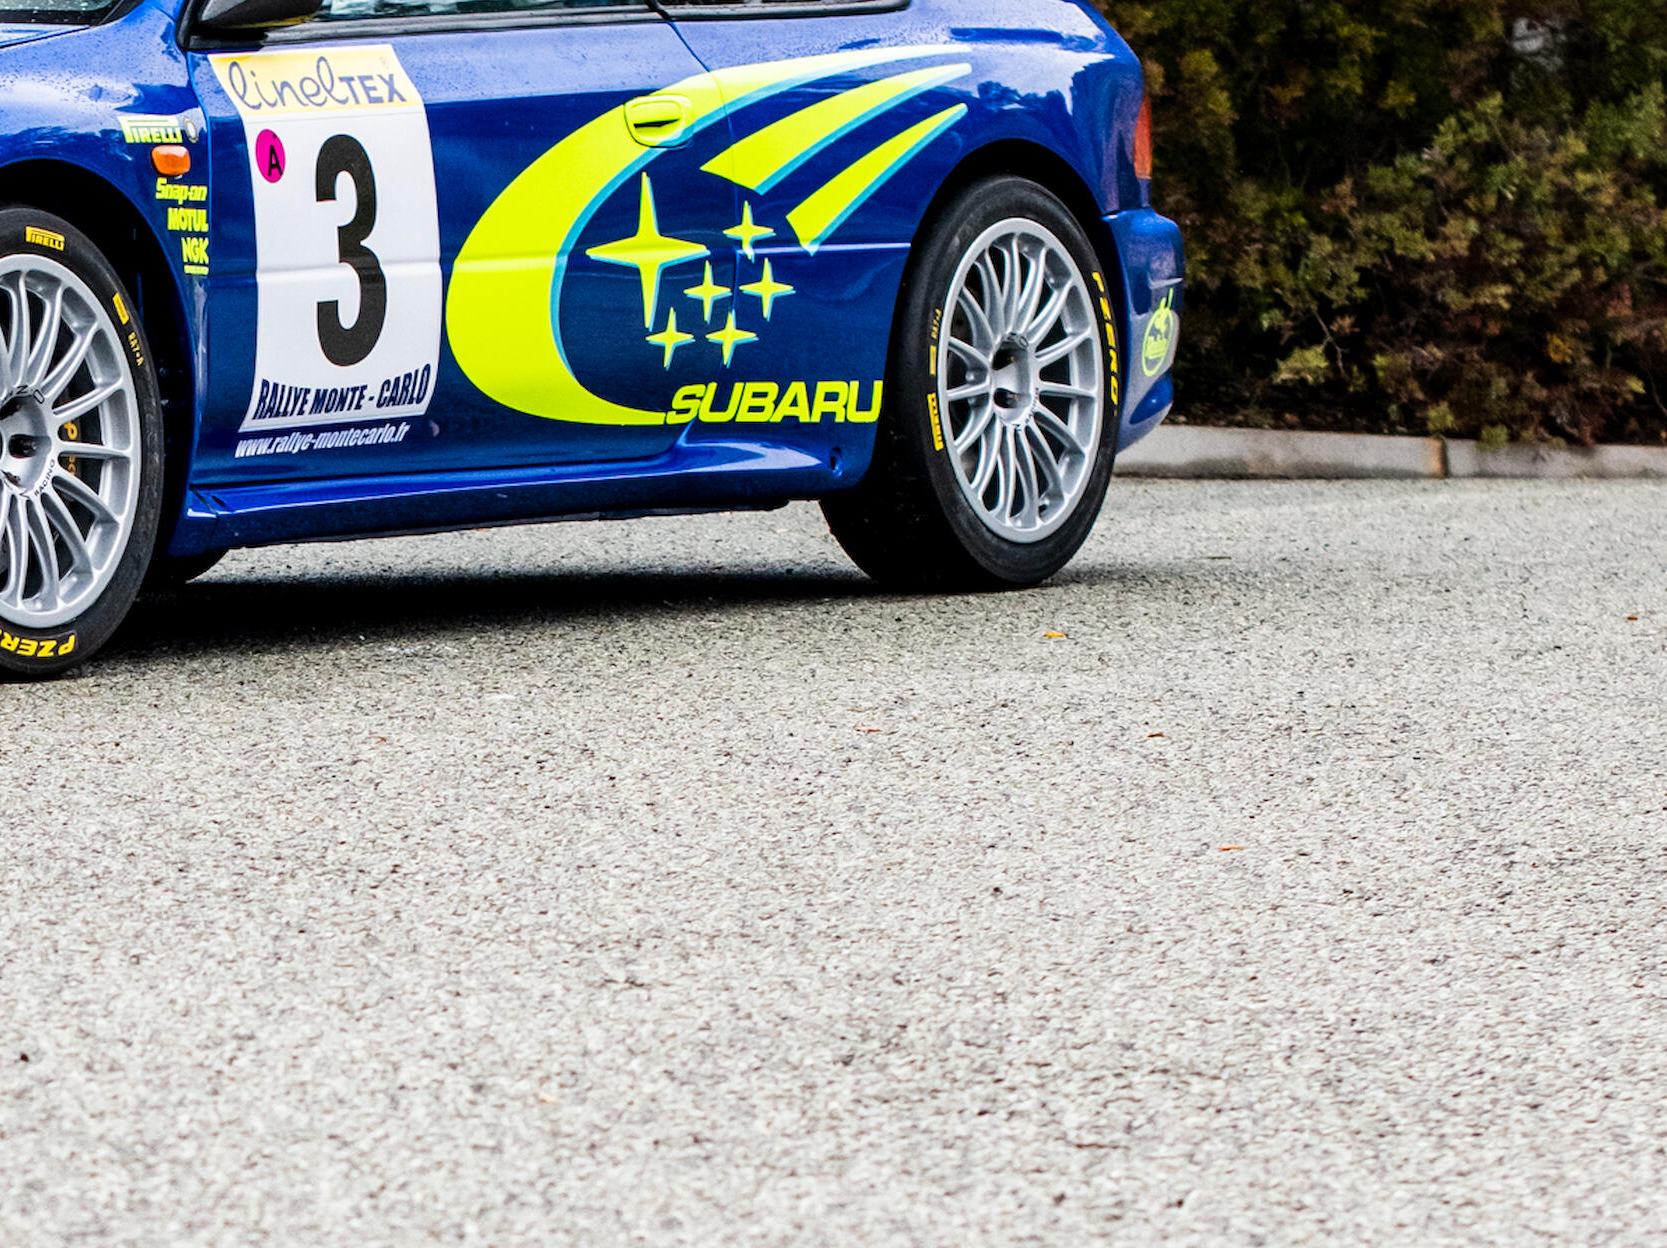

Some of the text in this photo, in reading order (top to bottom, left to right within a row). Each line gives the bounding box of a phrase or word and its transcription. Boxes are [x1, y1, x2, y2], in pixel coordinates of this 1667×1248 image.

[118, 114, 183, 143] PIRELLI
[267, 145, 283, 177] A
[155, 177, 208, 205] Snap-on
[167, 207, 209, 232] MOTUL
[25, 225, 65, 252] PIRELLI
[181, 237, 209, 264] NGK
[315, 134, 387, 367] 3
[252, 379, 310, 420] RALLYE
[309, 385, 368, 415] MONTE
[376, 363, 431, 408] CARLO
[664, 380, 883, 425] SUBARU
